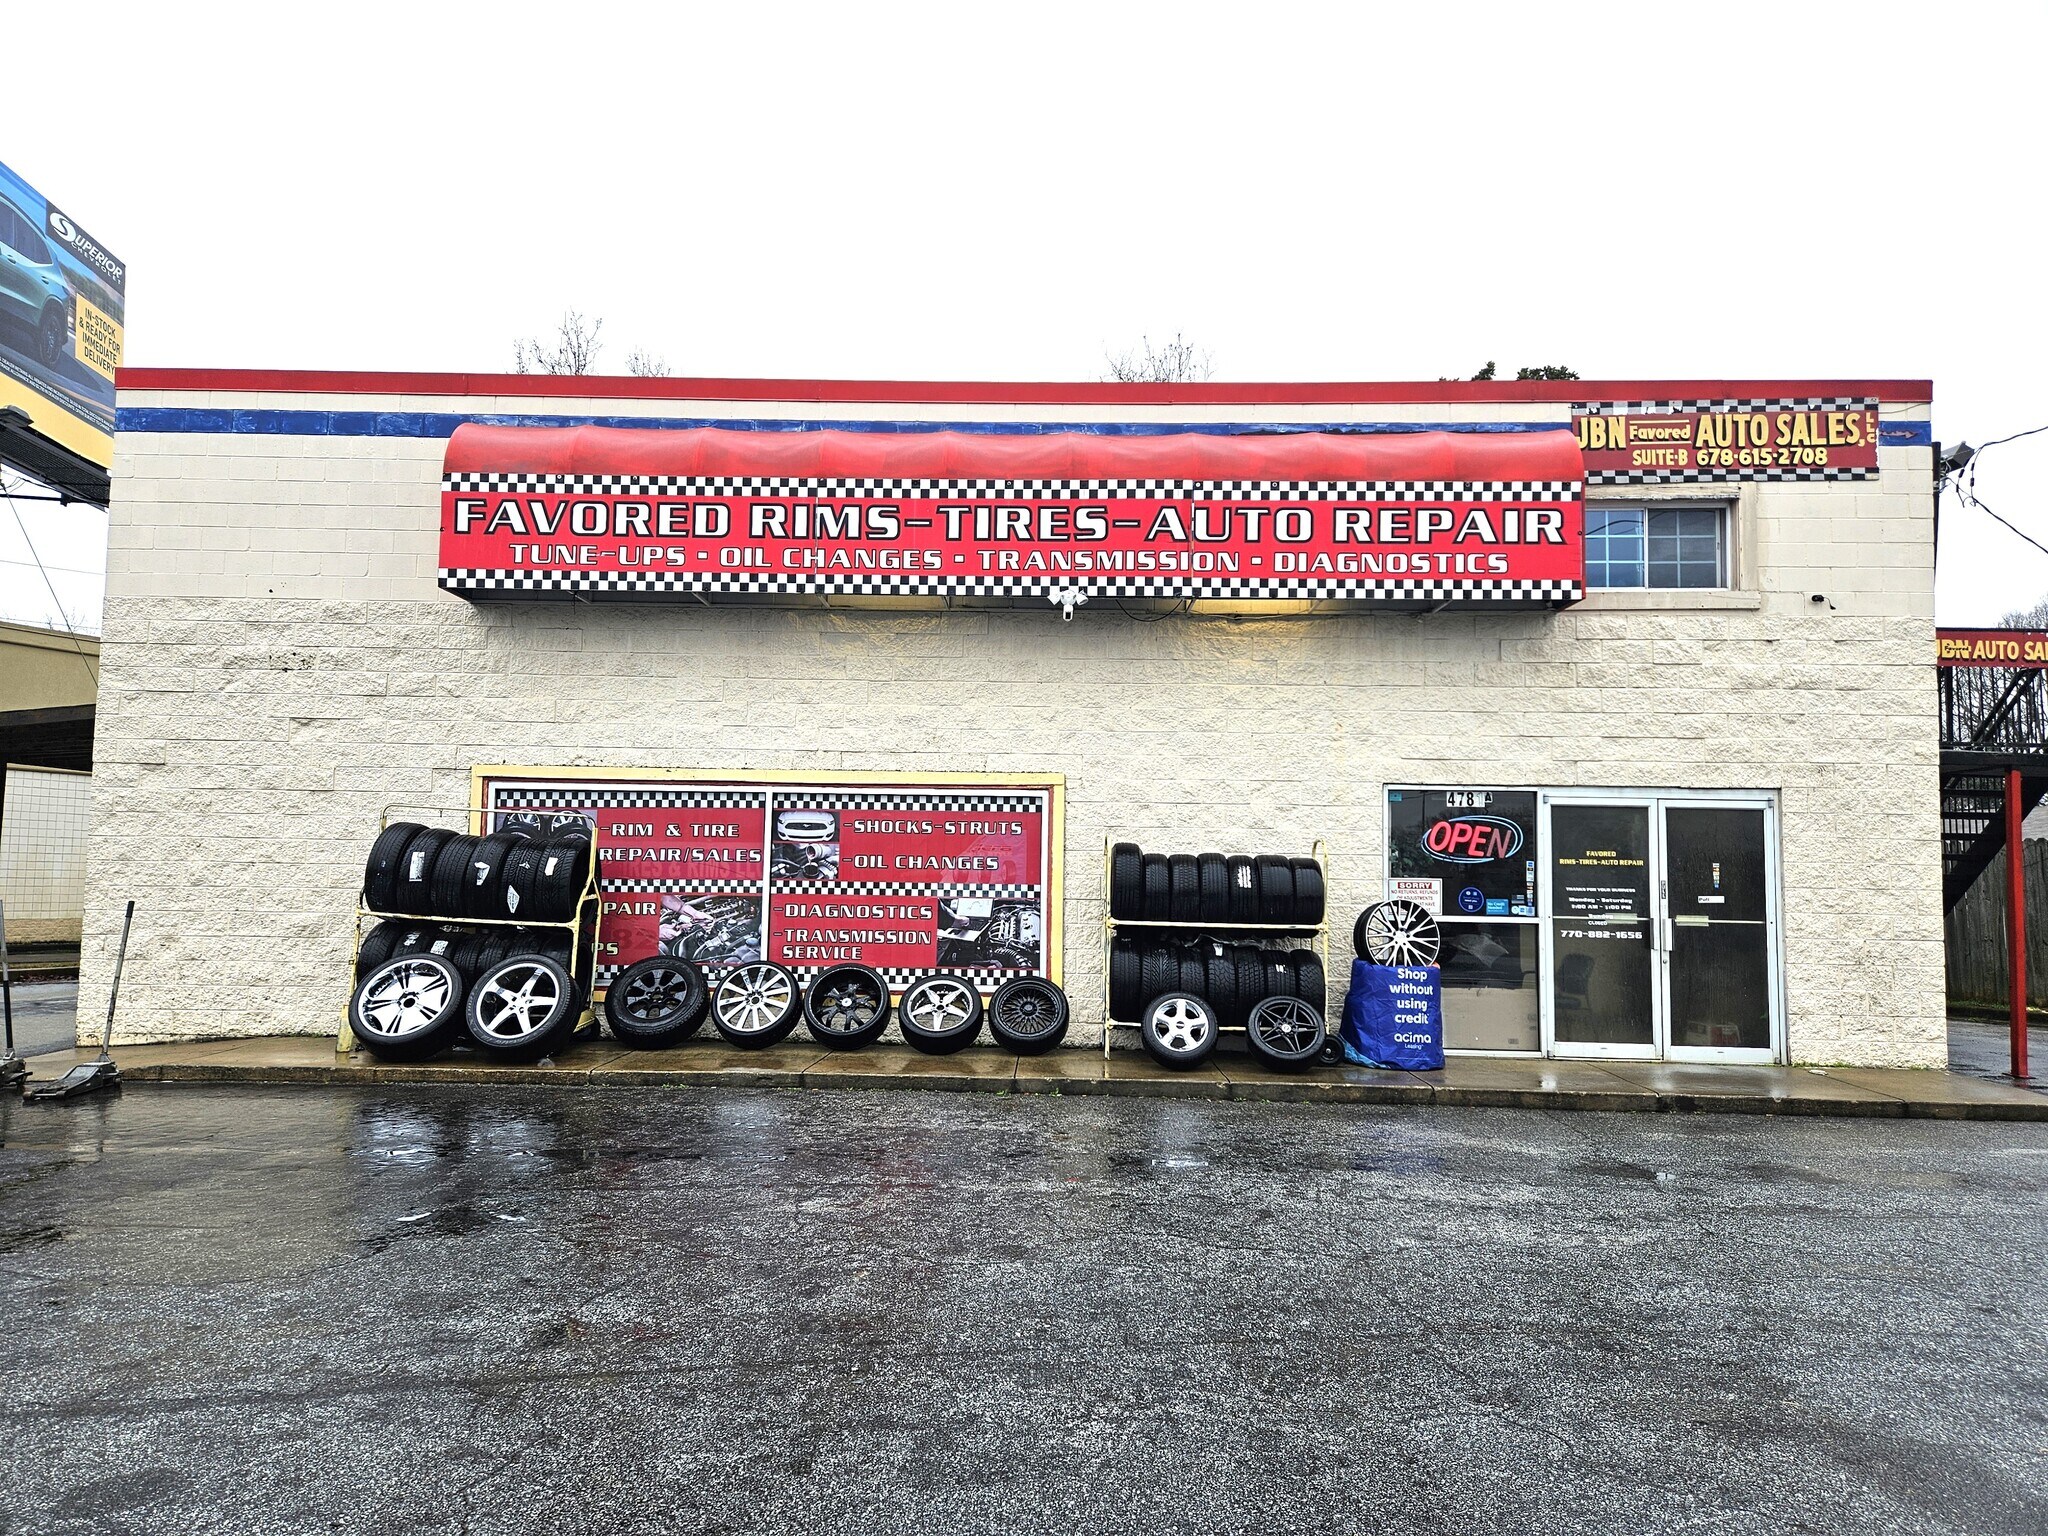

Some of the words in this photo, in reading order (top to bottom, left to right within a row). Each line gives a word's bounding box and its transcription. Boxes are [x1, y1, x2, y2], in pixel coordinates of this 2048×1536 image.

[50, 212, 122, 278] SUPERIOR
[85, 307, 116, 338] IN-STOCK
[86, 320, 107, 344] READY
[108, 337, 121, 355] FOR
[82, 331, 117, 364] IMMEDIATE
[84, 346, 115, 375] DELIVERY
[1575, 416, 1626, 449] JBN
[1629, 424, 1691, 441] Favored
[1695, 412, 1769, 447] AUTO
[1697, 448, 1828, 466] 678-615-2708
[454, 498, 732, 539] FAVORED
[1333, 508, 1566, 545] REPAIR
[509, 543, 686, 566] TUNE-UPS
[719, 547, 772, 568] OIL
[783, 548, 943, 570] CHANGES
[978, 550, 1239, 572] TRANSMISSION
[1273, 552, 1509, 574] DIAGNOSTICS
[1973, 640, 2020, 659] AUTO
[665, 823, 682, 837] &
[690, 824, 739, 837] TIRE
[1429, 821, 1512, 859] OPEN
[600, 848, 762, 863] REPAIR/SALES
[895, 856, 999, 871] CHANGES
[602, 901, 657, 915] PAIR
[591, 942, 619, 956] PS
[782, 945, 862, 960] SERVICE
[1397, 968, 1428, 982] Shop
[1389, 983, 1434, 995] without
[1397, 998, 1428, 1011] using
[1394, 1032, 1431, 1043] acima
